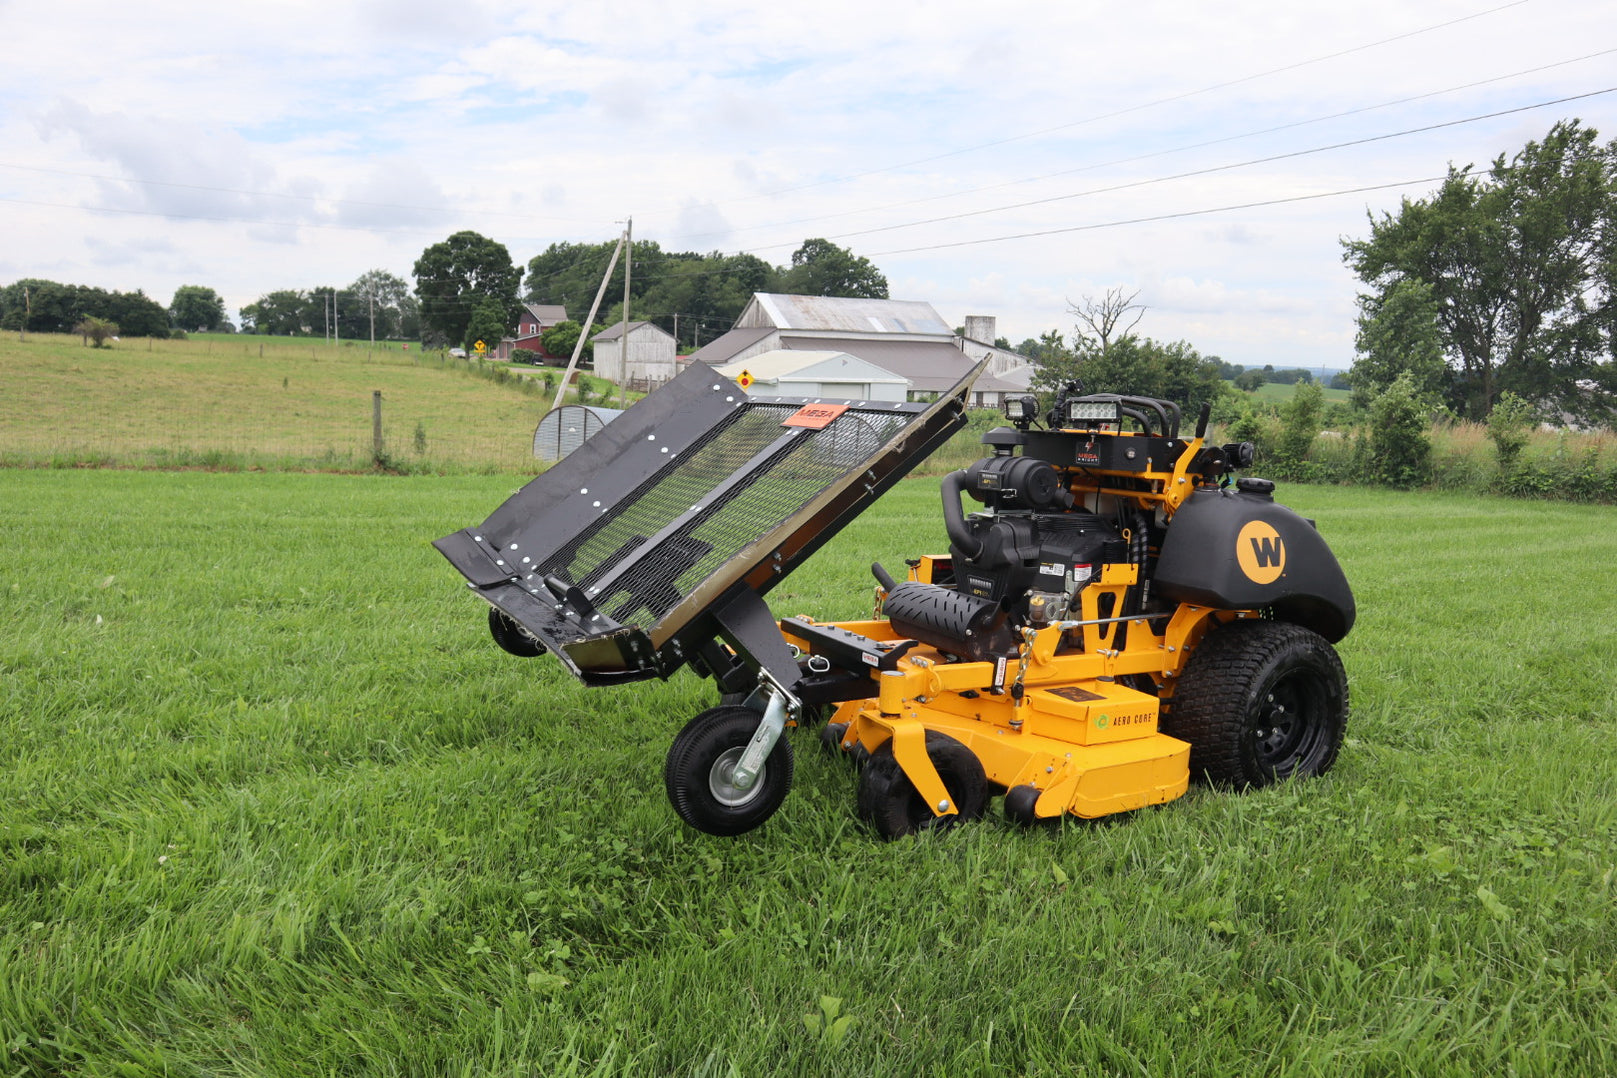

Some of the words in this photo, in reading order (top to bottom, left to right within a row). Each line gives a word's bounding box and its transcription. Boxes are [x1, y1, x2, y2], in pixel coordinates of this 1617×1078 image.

[796, 409, 834, 418] MEGA
[1250, 536, 1281, 567] W
[1113, 715, 1131, 726] AERO
